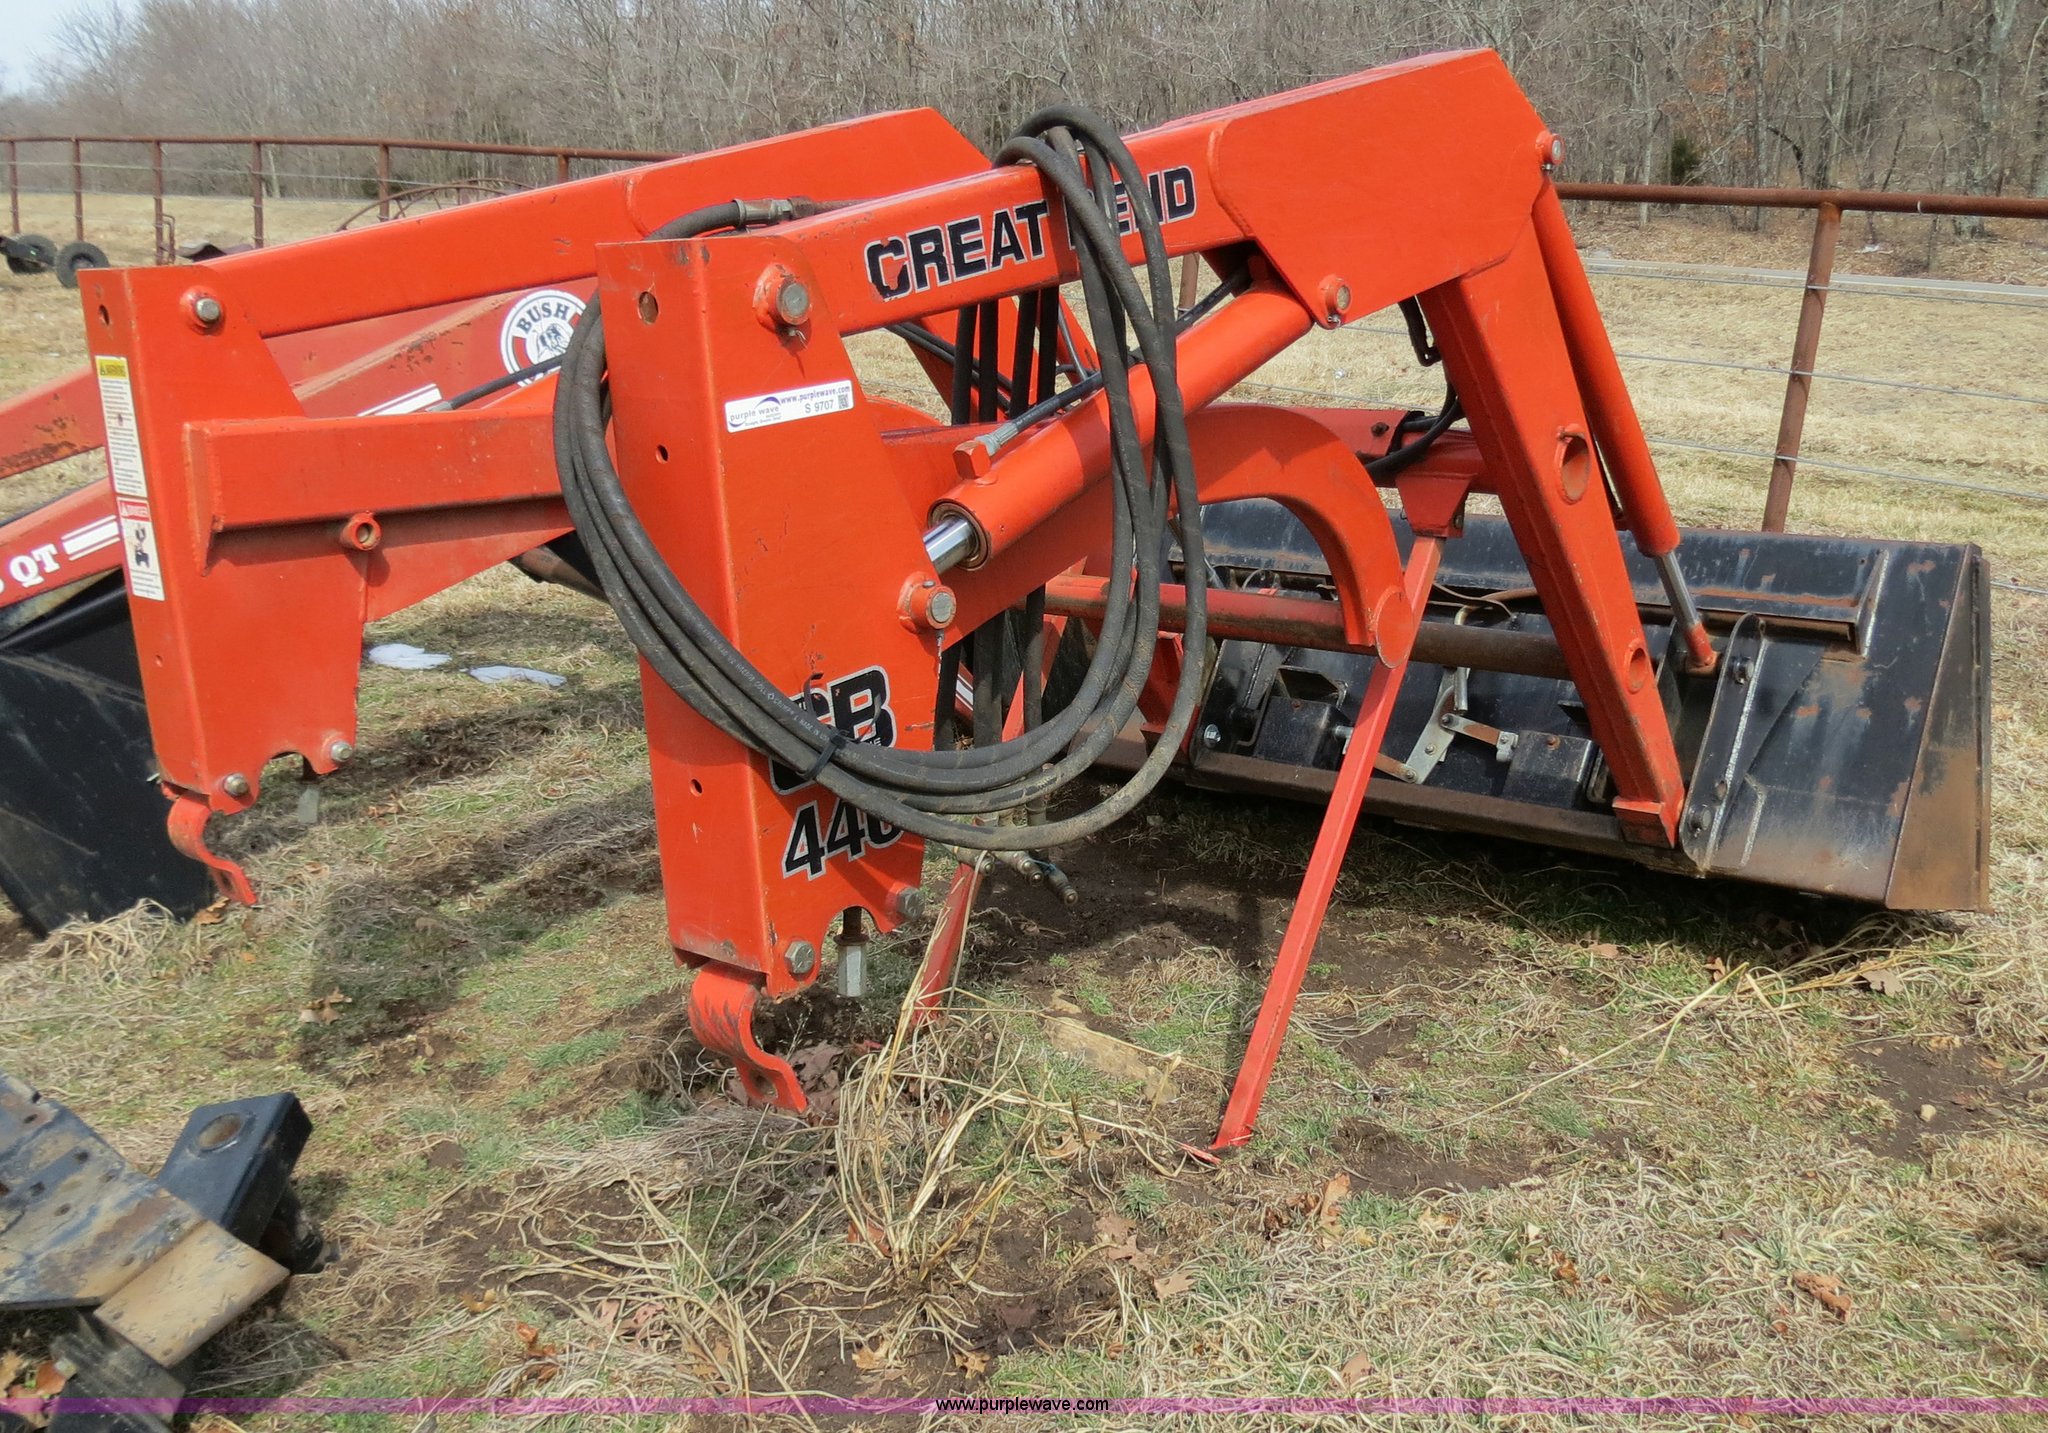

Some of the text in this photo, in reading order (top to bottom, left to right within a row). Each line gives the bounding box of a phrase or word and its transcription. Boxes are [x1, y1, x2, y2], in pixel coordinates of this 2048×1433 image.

[516, 302, 570, 335] BUSH
[780, 385, 849, 403] www.purplewave.com
[730, 409, 757, 422] purple
[758, 405, 780, 415] wave
[804, 400, 834, 414] S 9707
[9, 543, 60, 588] QT
